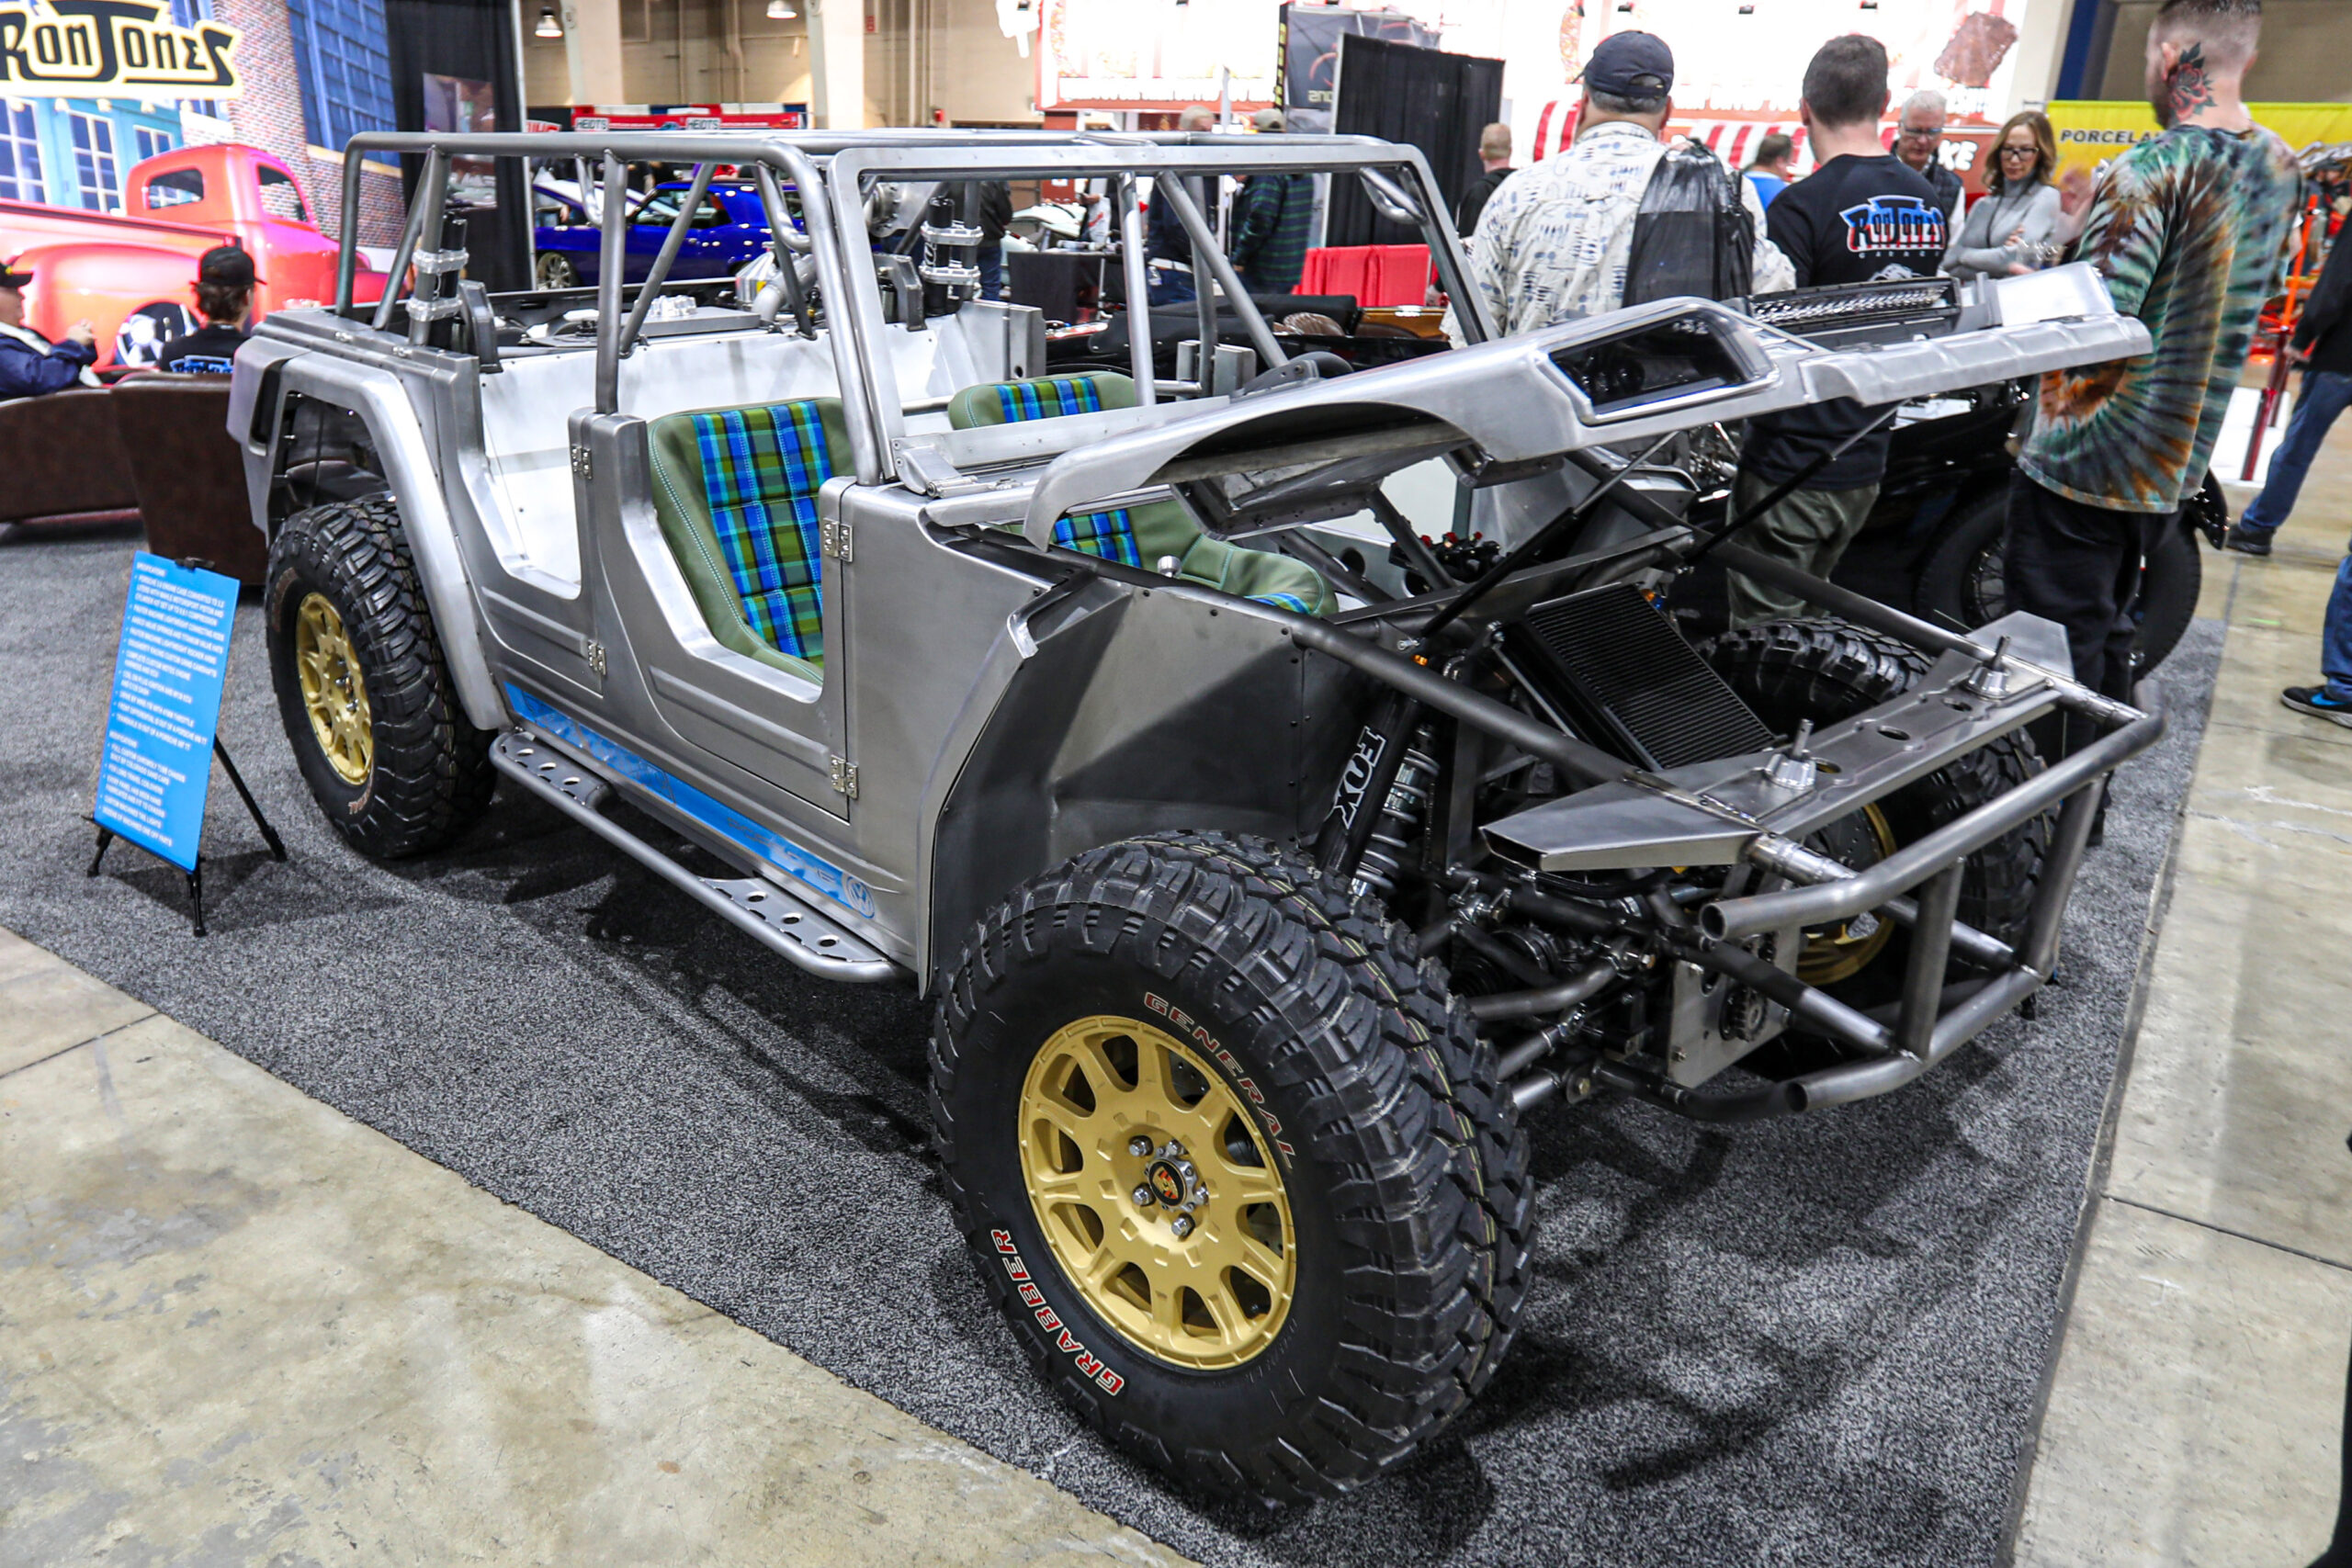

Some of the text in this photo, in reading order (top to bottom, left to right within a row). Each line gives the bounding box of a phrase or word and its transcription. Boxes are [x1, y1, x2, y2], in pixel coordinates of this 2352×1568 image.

[2060, 130, 2160, 143] PORCELA
[1333, 725, 1386, 830] FOX
[1144, 991, 1295, 1169] GENERAL
[990, 1229, 1125, 1396] GRABBER
